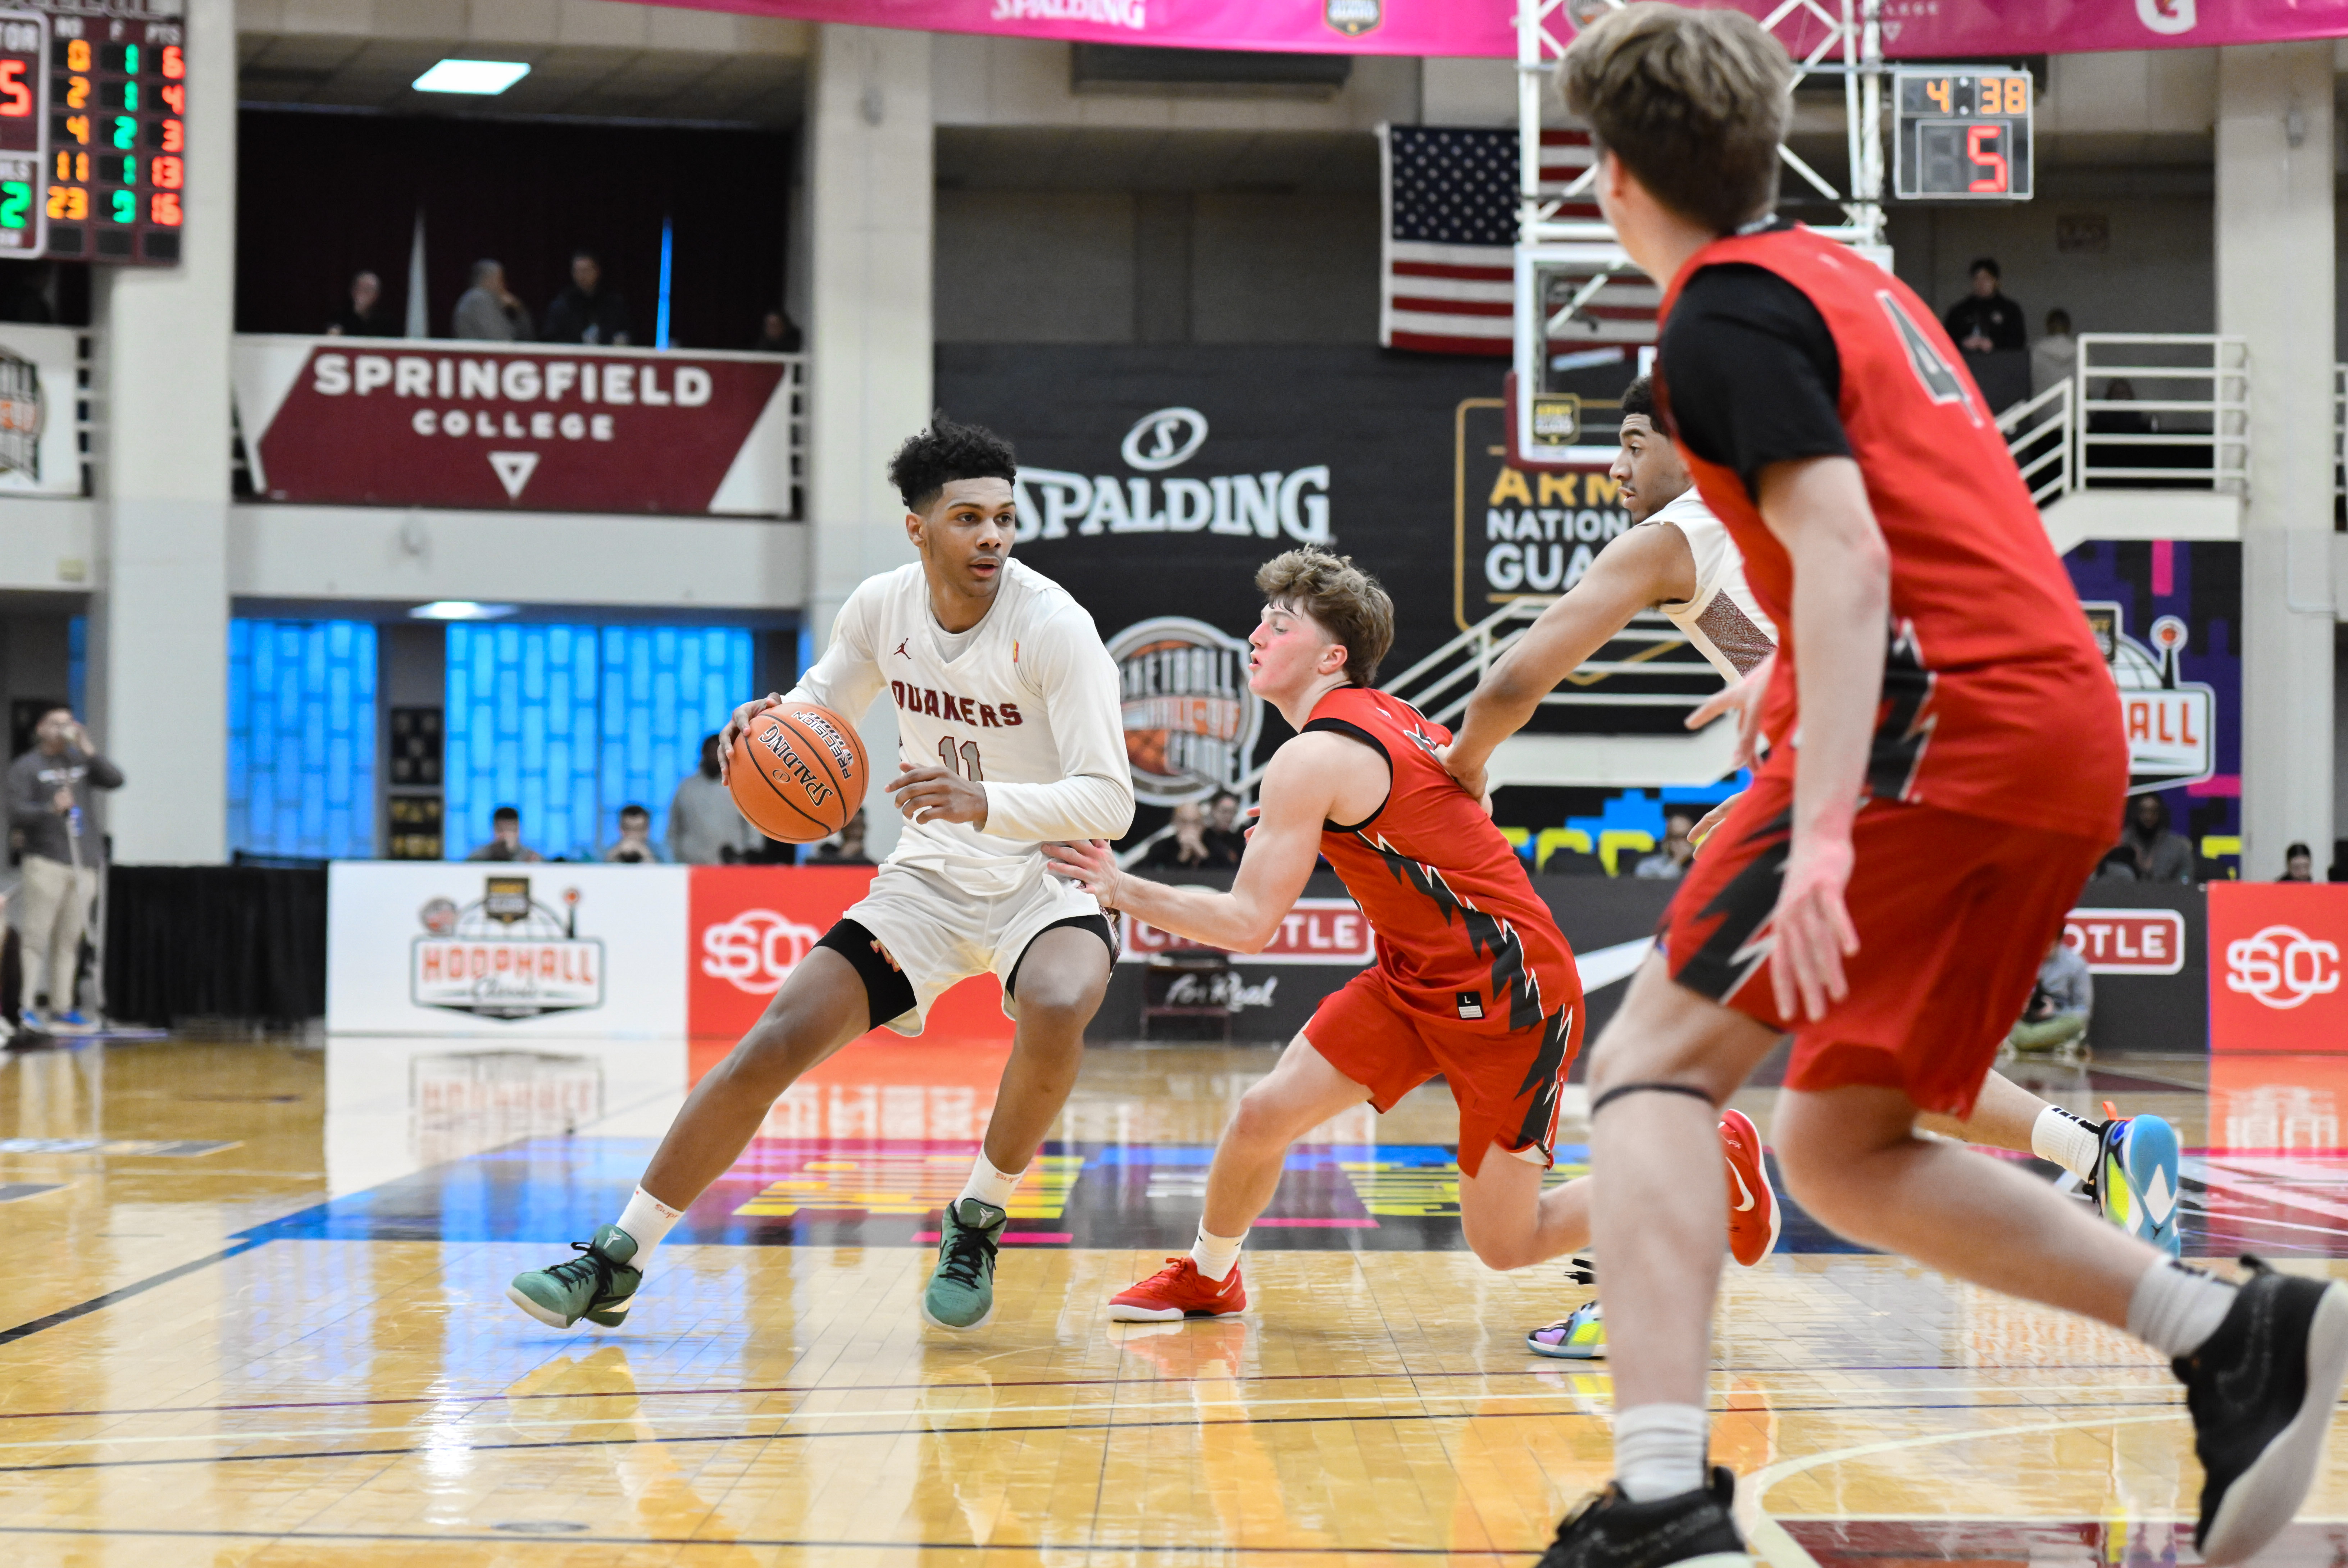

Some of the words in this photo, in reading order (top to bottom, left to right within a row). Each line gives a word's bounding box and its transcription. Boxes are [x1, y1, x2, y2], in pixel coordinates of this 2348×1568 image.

[125, 44, 139, 75] 1
[67, 76, 91, 109] 2
[124, 81, 138, 111] 1
[162, 84, 185, 115] 4
[67, 115, 90, 145] 4
[114, 116, 137, 150] 2
[162, 119, 184, 152] 3
[57, 150, 89, 183] 11
[123, 154, 136, 185] 1
[1967, 125, 2008, 193] 5
[0, 181, 32, 229] 2
[46, 185, 88, 220] 23
[112, 190, 136, 224] 9
[313, 353, 714, 407] SPRINGFIELD
[412, 409, 615, 441] COLLEGE
[1012, 465, 1330, 544] SPALDING
[1488, 467, 1624, 505] ARM
[1486, 509, 1631, 541] NATION
[1485, 542, 1594, 591] GUA
[891, 679, 1023, 728] QUAKERS
[807, 712, 846, 747] 1000
[2129, 701, 2199, 747] ALL
[758, 723, 833, 807] SPALDING
[791, 711, 852, 780] PRECISION
[938, 735, 984, 782] 11
[422, 945, 595, 985] HOOPHALL
[1464, 995, 1471, 1004] L
